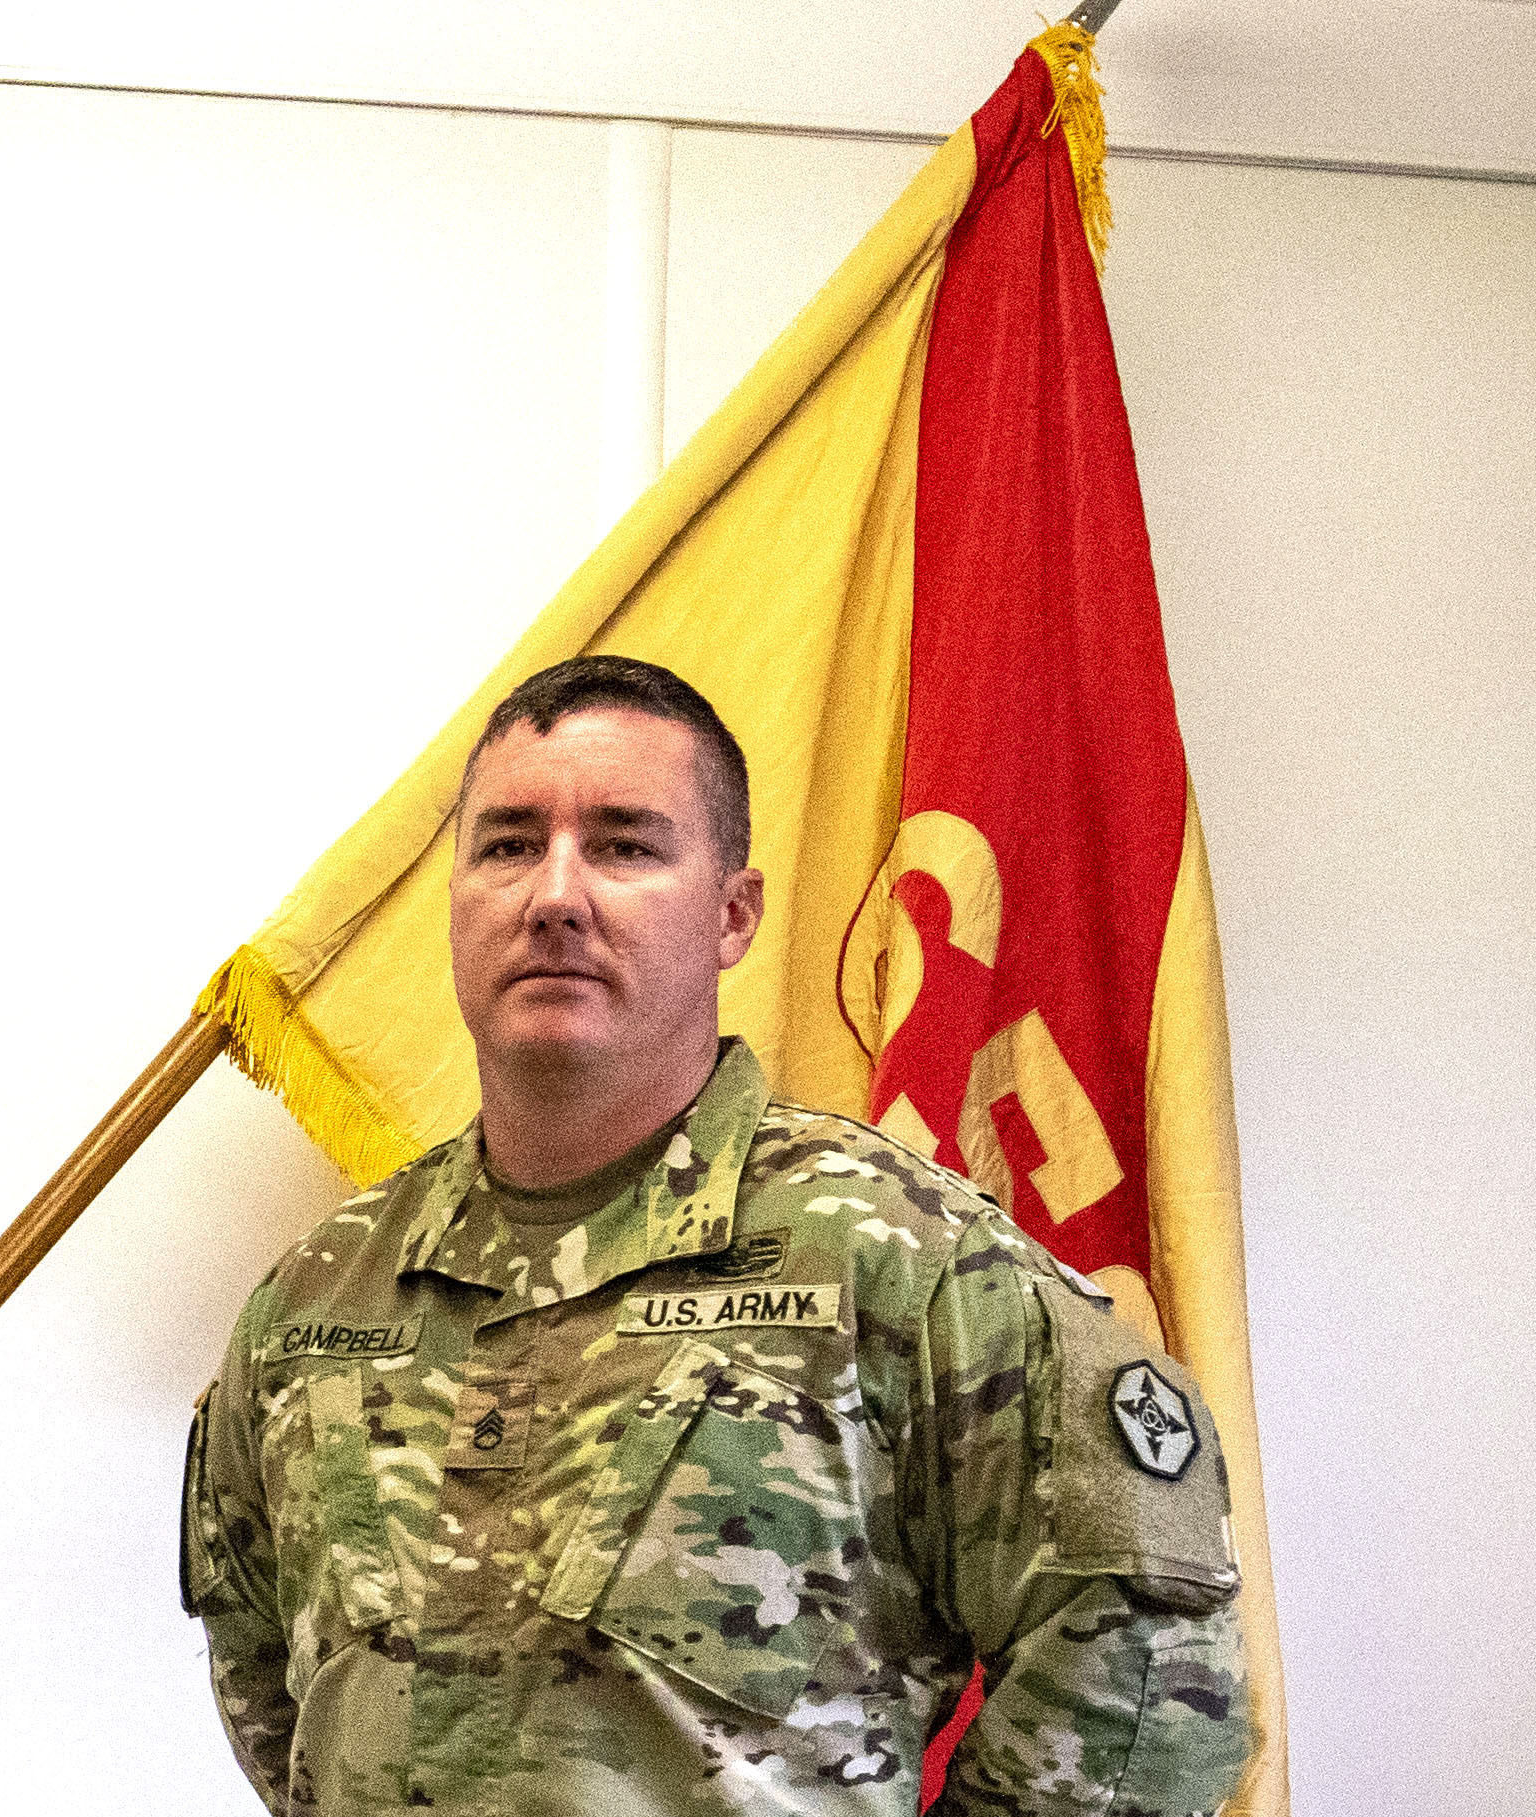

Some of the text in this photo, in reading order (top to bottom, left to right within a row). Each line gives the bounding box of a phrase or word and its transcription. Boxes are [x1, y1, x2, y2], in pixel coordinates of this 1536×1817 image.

[643, 1291, 817, 1328] U.S. ARMY
[282, 1323, 405, 1353] CAMPBELL
